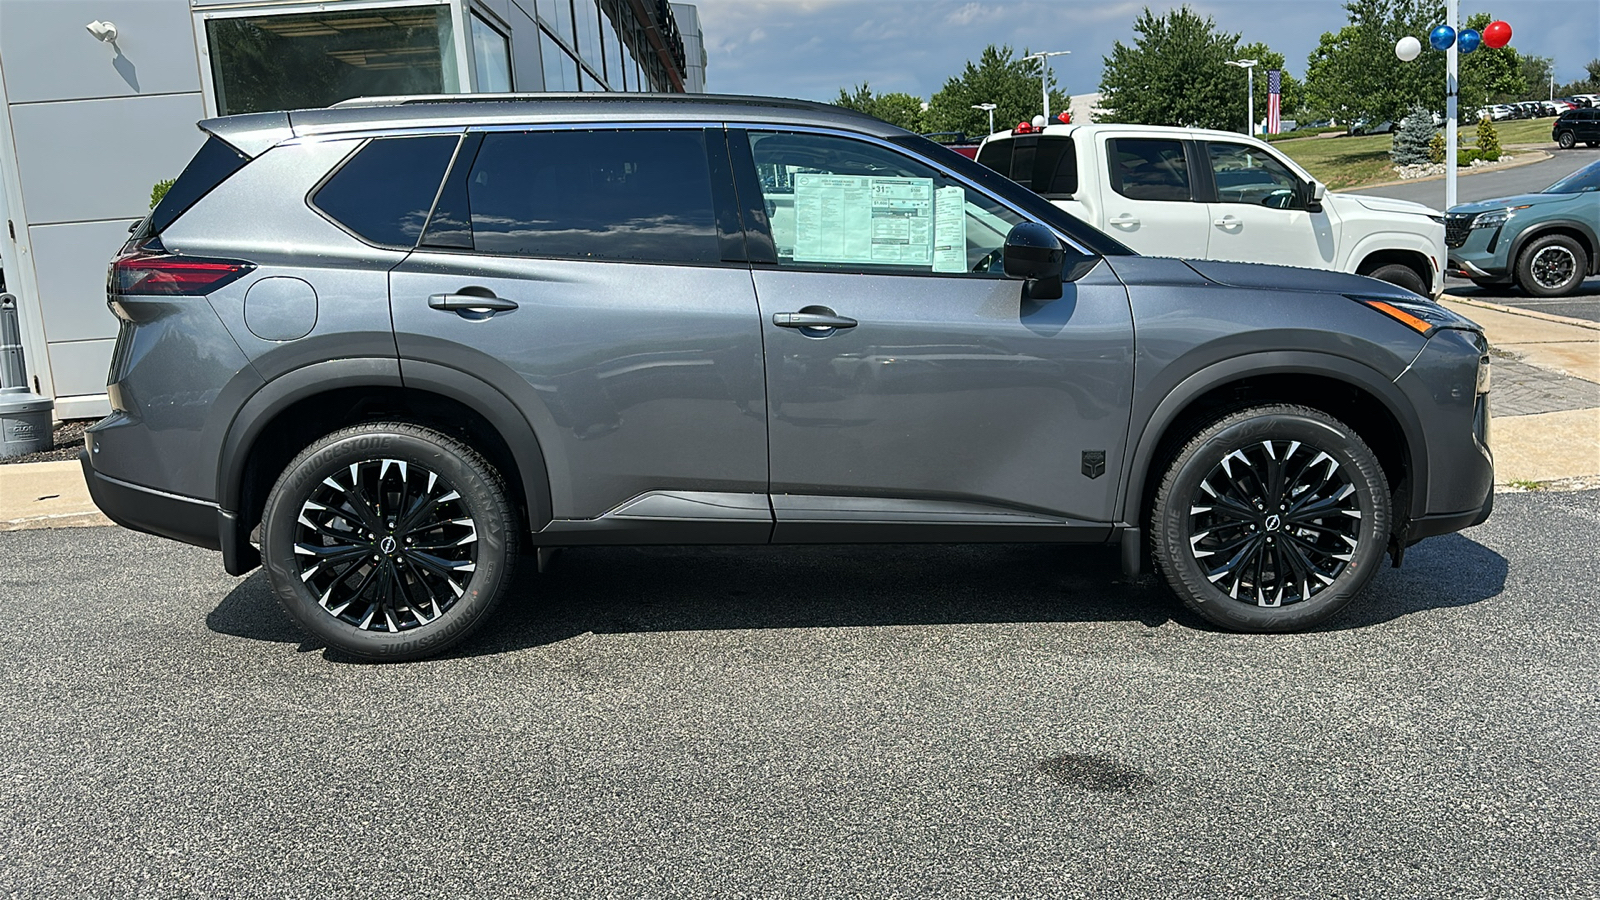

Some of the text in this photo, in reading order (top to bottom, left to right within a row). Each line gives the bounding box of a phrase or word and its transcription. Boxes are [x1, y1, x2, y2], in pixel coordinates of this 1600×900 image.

[876, 185, 885, 193] 31
[292, 437, 391, 490] BRIDGESTONE
[380, 602, 477, 656] BRIDGESTONE
